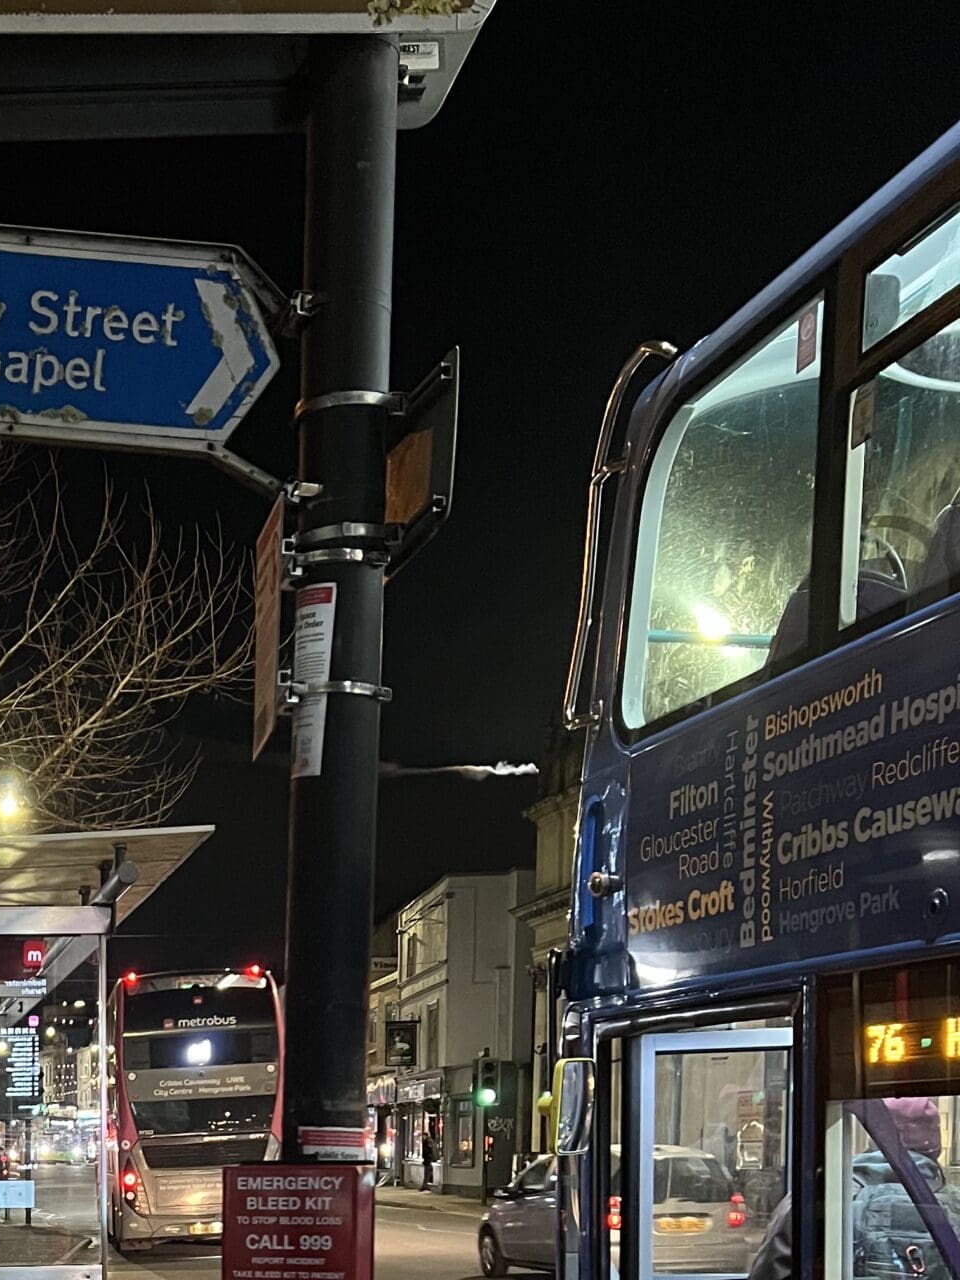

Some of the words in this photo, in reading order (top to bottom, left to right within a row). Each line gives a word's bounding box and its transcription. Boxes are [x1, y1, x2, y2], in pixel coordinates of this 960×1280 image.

[28, 290, 182, 347] Street
[765, 668, 882, 740] Bishopsworth
[762, 704, 885, 782] Southmead
[871, 736, 960, 790] Redcliffe
[669, 780, 718, 820] Filton
[723, 730, 739, 868] Hartcliffe
[779, 772, 867, 820] Patchway
[640, 817, 720, 862] Gloucester
[740, 714, 758, 949] Bedminster
[777, 818, 848, 865] Cribbs
[679, 842, 720, 880] Road
[759, 790, 774, 943] Withywood
[779, 861, 844, 903] Horfield
[628, 899, 684, 935] Stokes
[687, 879, 736, 921] Croft
[779, 895, 855, 935] Hengrove
[859, 884, 901, 918] Park
[178, 1015, 237, 1028] metrobus
[153, 1089, 168, 1097] City
[237, 1176, 344, 1190] EMERGENCY
[246, 1197, 301, 1210] BLEED
[305, 1197, 333, 1211] KIT
[237, 1216, 249, 1225] TO
[252, 1216, 278, 1225] STOP
[279, 1216, 313, 1225] BLOOD
[316, 1217, 342, 1225] LOSS
[245, 1234, 295, 1250] CALL
[300, 1235, 332, 1251] 999
[233, 1270, 253, 1278] TAKE
[255, 1270, 281, 1279] BLEED
[283, 1271, 296, 1279] KIT
[298, 1271, 309, 1279] TO
[311, 1271, 345, 1280] PATIENT
